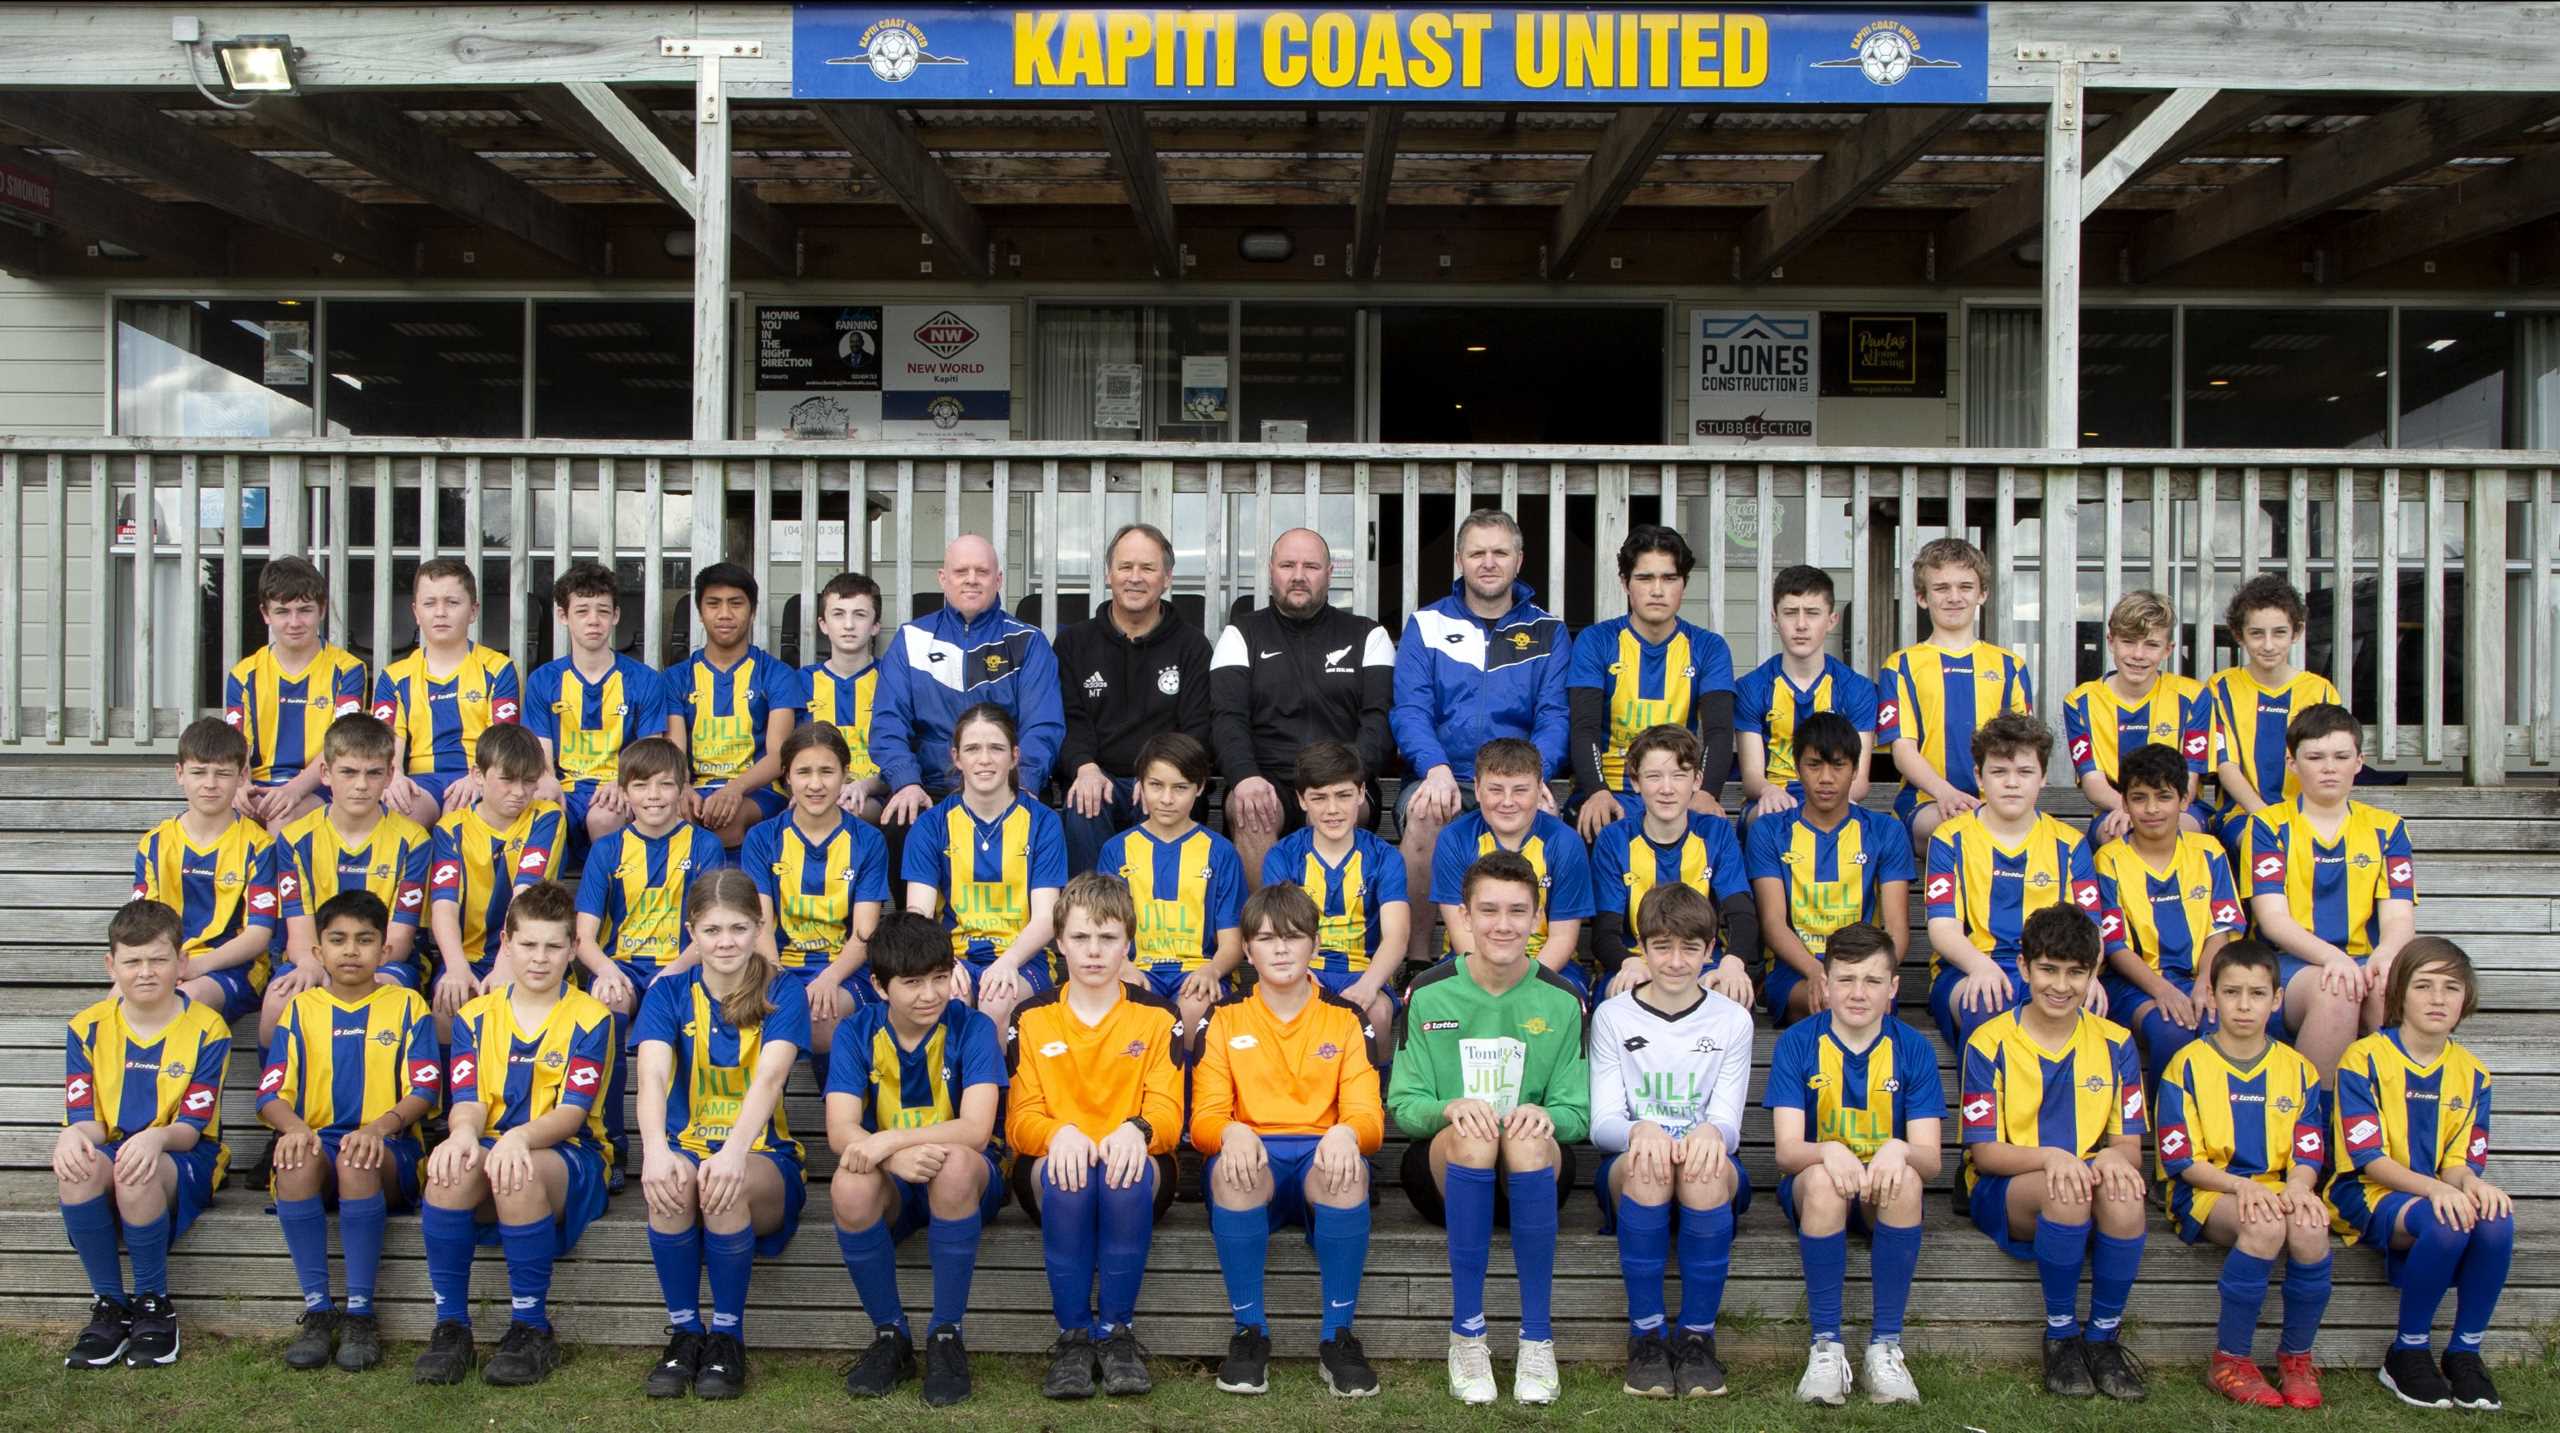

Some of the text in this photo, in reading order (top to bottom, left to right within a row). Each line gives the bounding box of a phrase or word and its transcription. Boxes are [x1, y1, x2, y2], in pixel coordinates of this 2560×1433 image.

[859, 18, 928, 48] KAPITI COAST UNITED
[1851, 20, 1920, 50] KAPITI COAST UNITED
[1012, 11, 1769, 89] KAPITI COAST UNITED
[8, 175, 49, 208] SMOKING
[761, 311, 800, 320] MOVING
[761, 320, 782, 330] YOU
[835, 320, 878, 330] FANNING
[761, 330, 772, 340] IN
[930, 328, 963, 342] NW
[761, 340, 781, 349] THE
[761, 349, 792, 358] RIGHT
[761, 358, 813, 367] DIRECTION
[907, 363, 985, 373] NEW WORLD
[934, 376, 959, 384] Kapiti
[1702, 377, 1797, 391] CONSTRUCTION
[1698, 422, 1812, 435] STUBBELECTRIC
[694, 718, 752, 741] JILL
[956, 884, 1021, 914] JILL
[1795, 884, 1860, 912] JILL
[1138, 903, 1196, 933] JILL
[1432, 1021, 1459, 1029] lotto
[1469, 1067, 1515, 1093] JILL
[1634, 1072, 1702, 1101] JILL
[695, 1101, 738, 1118] LAMP
[1822, 1109, 1889, 1139] JILL
